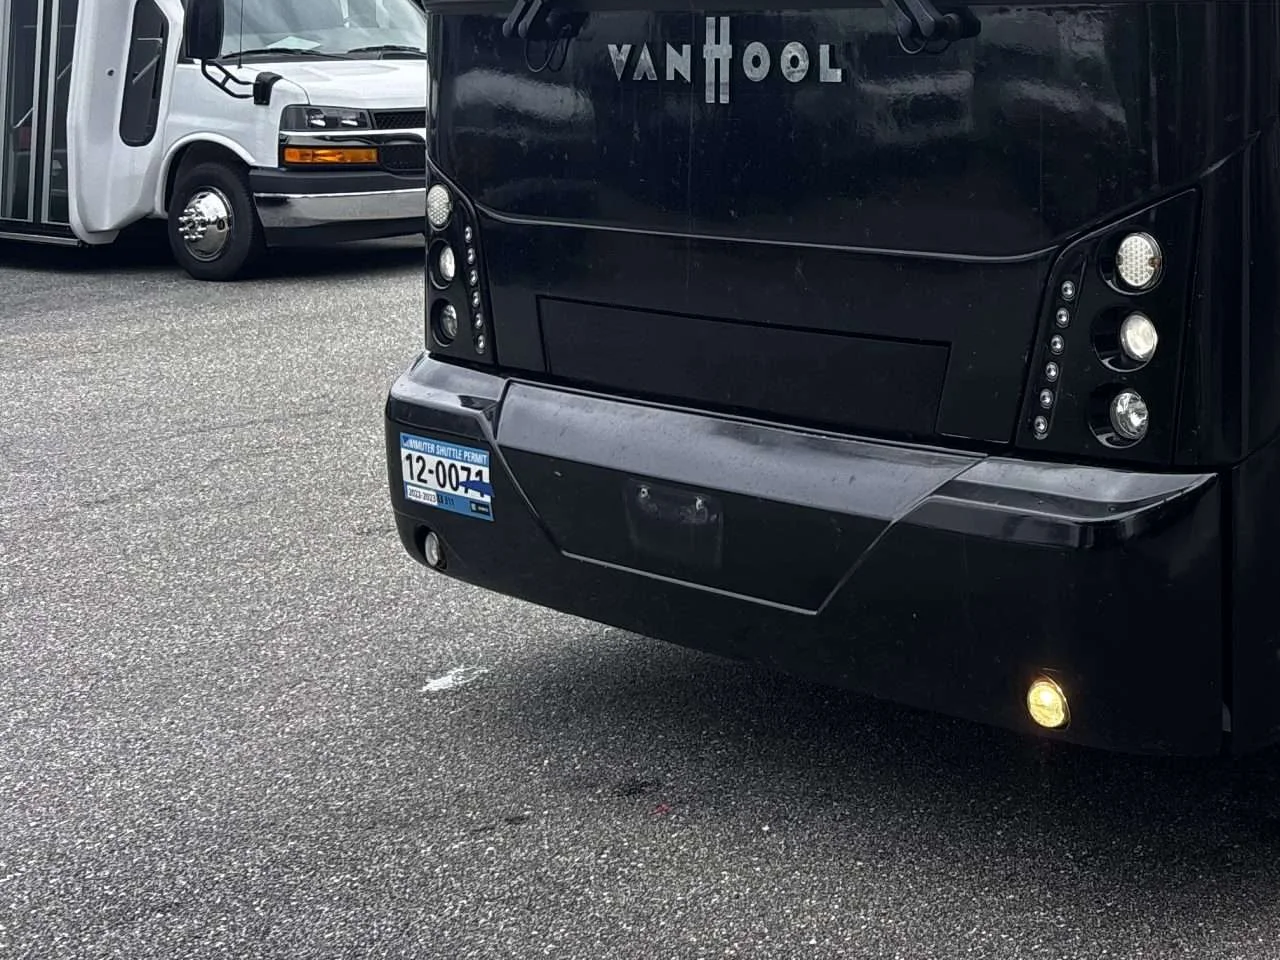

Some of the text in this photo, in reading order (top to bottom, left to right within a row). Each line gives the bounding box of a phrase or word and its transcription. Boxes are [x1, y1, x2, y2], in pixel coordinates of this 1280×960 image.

[435, 444, 462, 460] SHUTTLE
[463, 451, 488, 465] PERMIT
[405, 453, 485, 498] 12-0071
